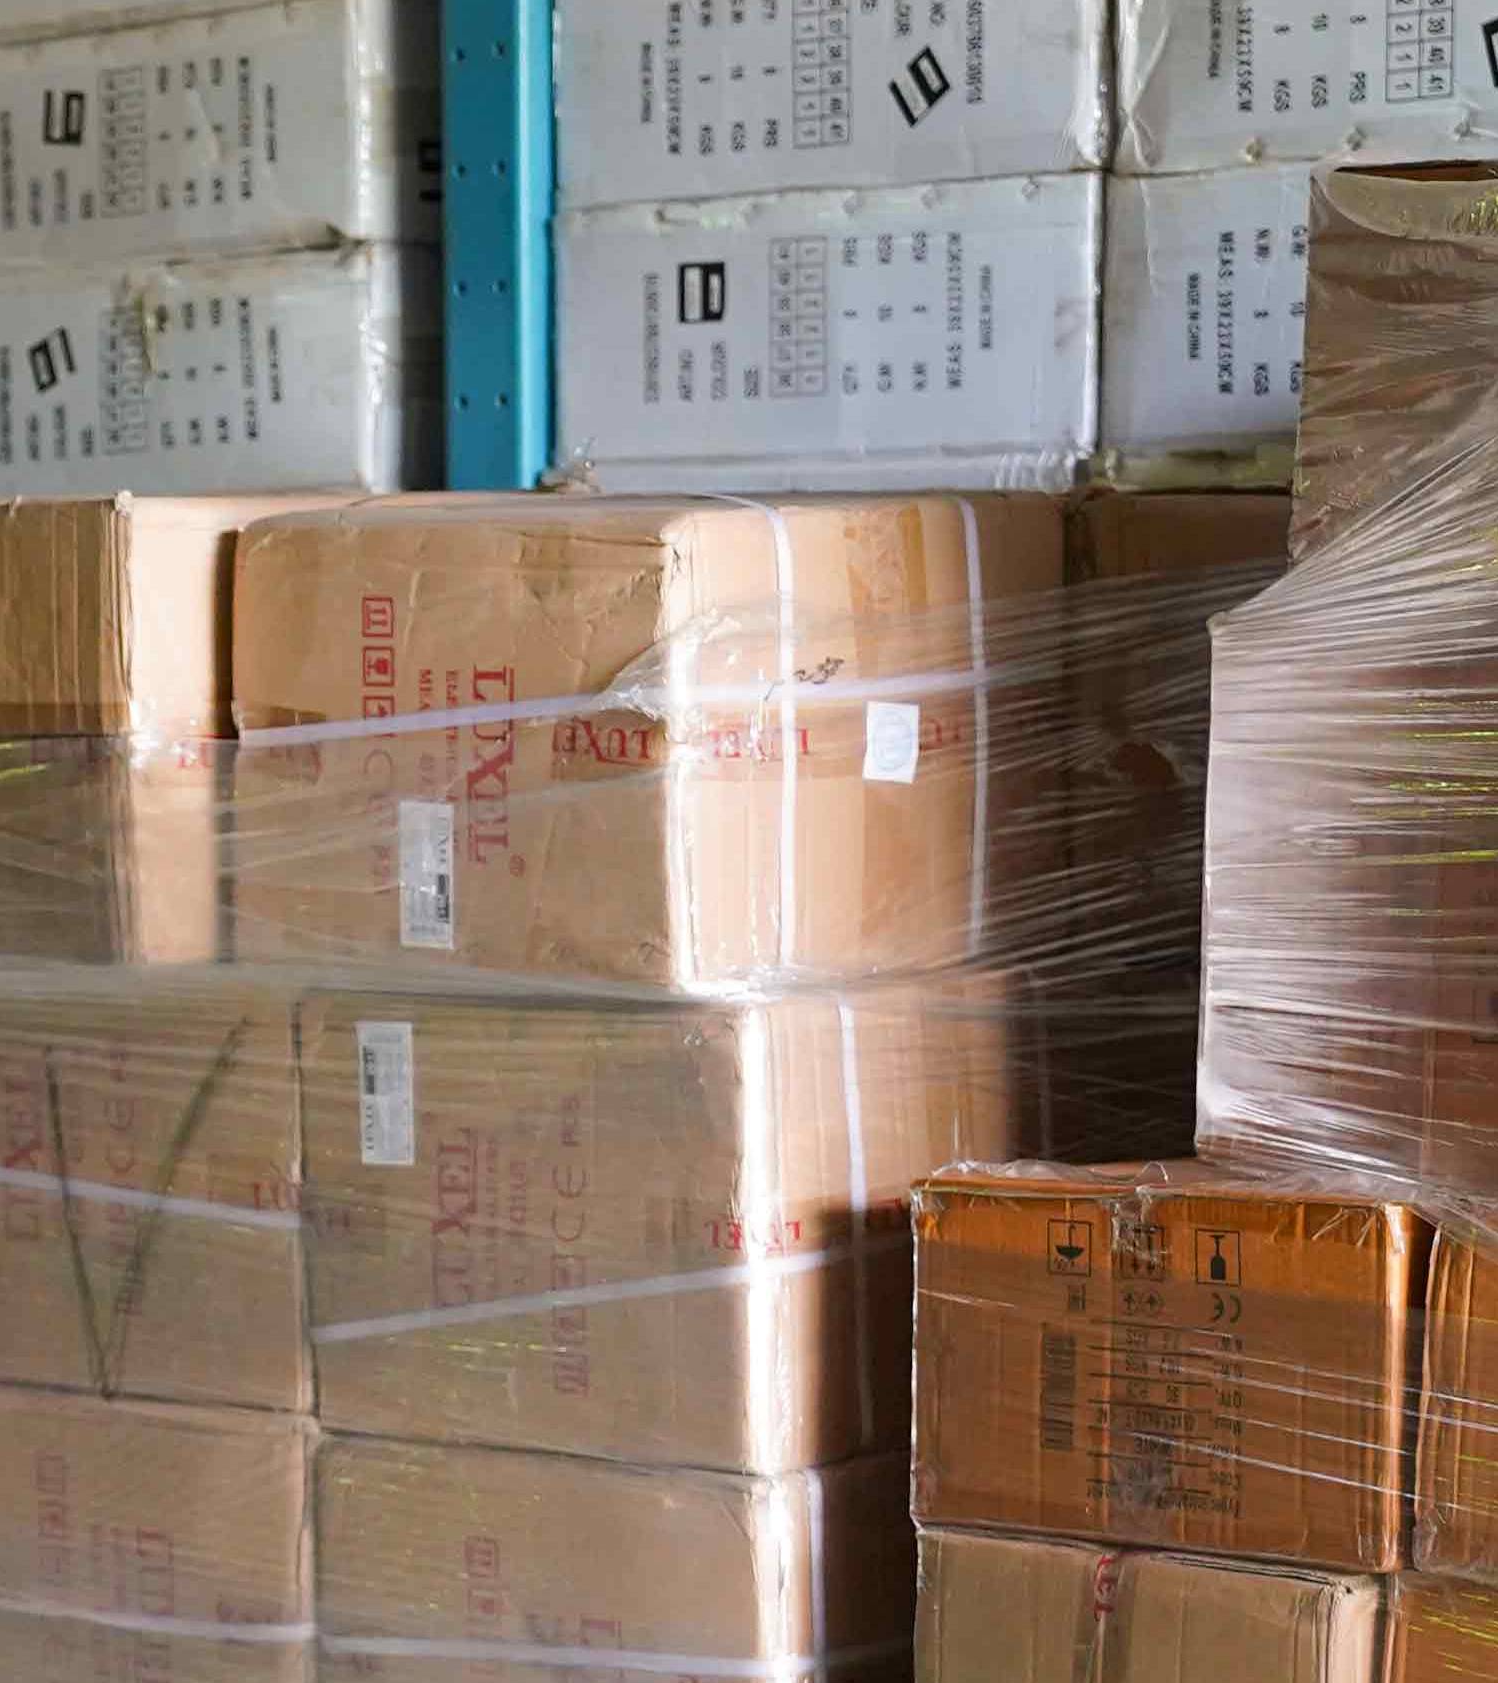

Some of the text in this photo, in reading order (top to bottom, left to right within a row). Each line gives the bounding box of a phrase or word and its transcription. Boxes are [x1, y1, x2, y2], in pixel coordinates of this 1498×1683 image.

[1273, 78, 1291, 112] KGS
[1311, 74, 1328, 112] KGS
[1349, 71, 1367, 104] PRS
[1427, 73, 1445, 93] 41
[912, 230, 928, 264] KGS
[1187, 273, 1202, 307] MADE
[1187, 323, 1202, 361] CHINA
[1253, 361, 1270, 398] KGS
[559, 1095, 580, 1148] PCS
[432, 1126, 478, 1313] LUXEL
